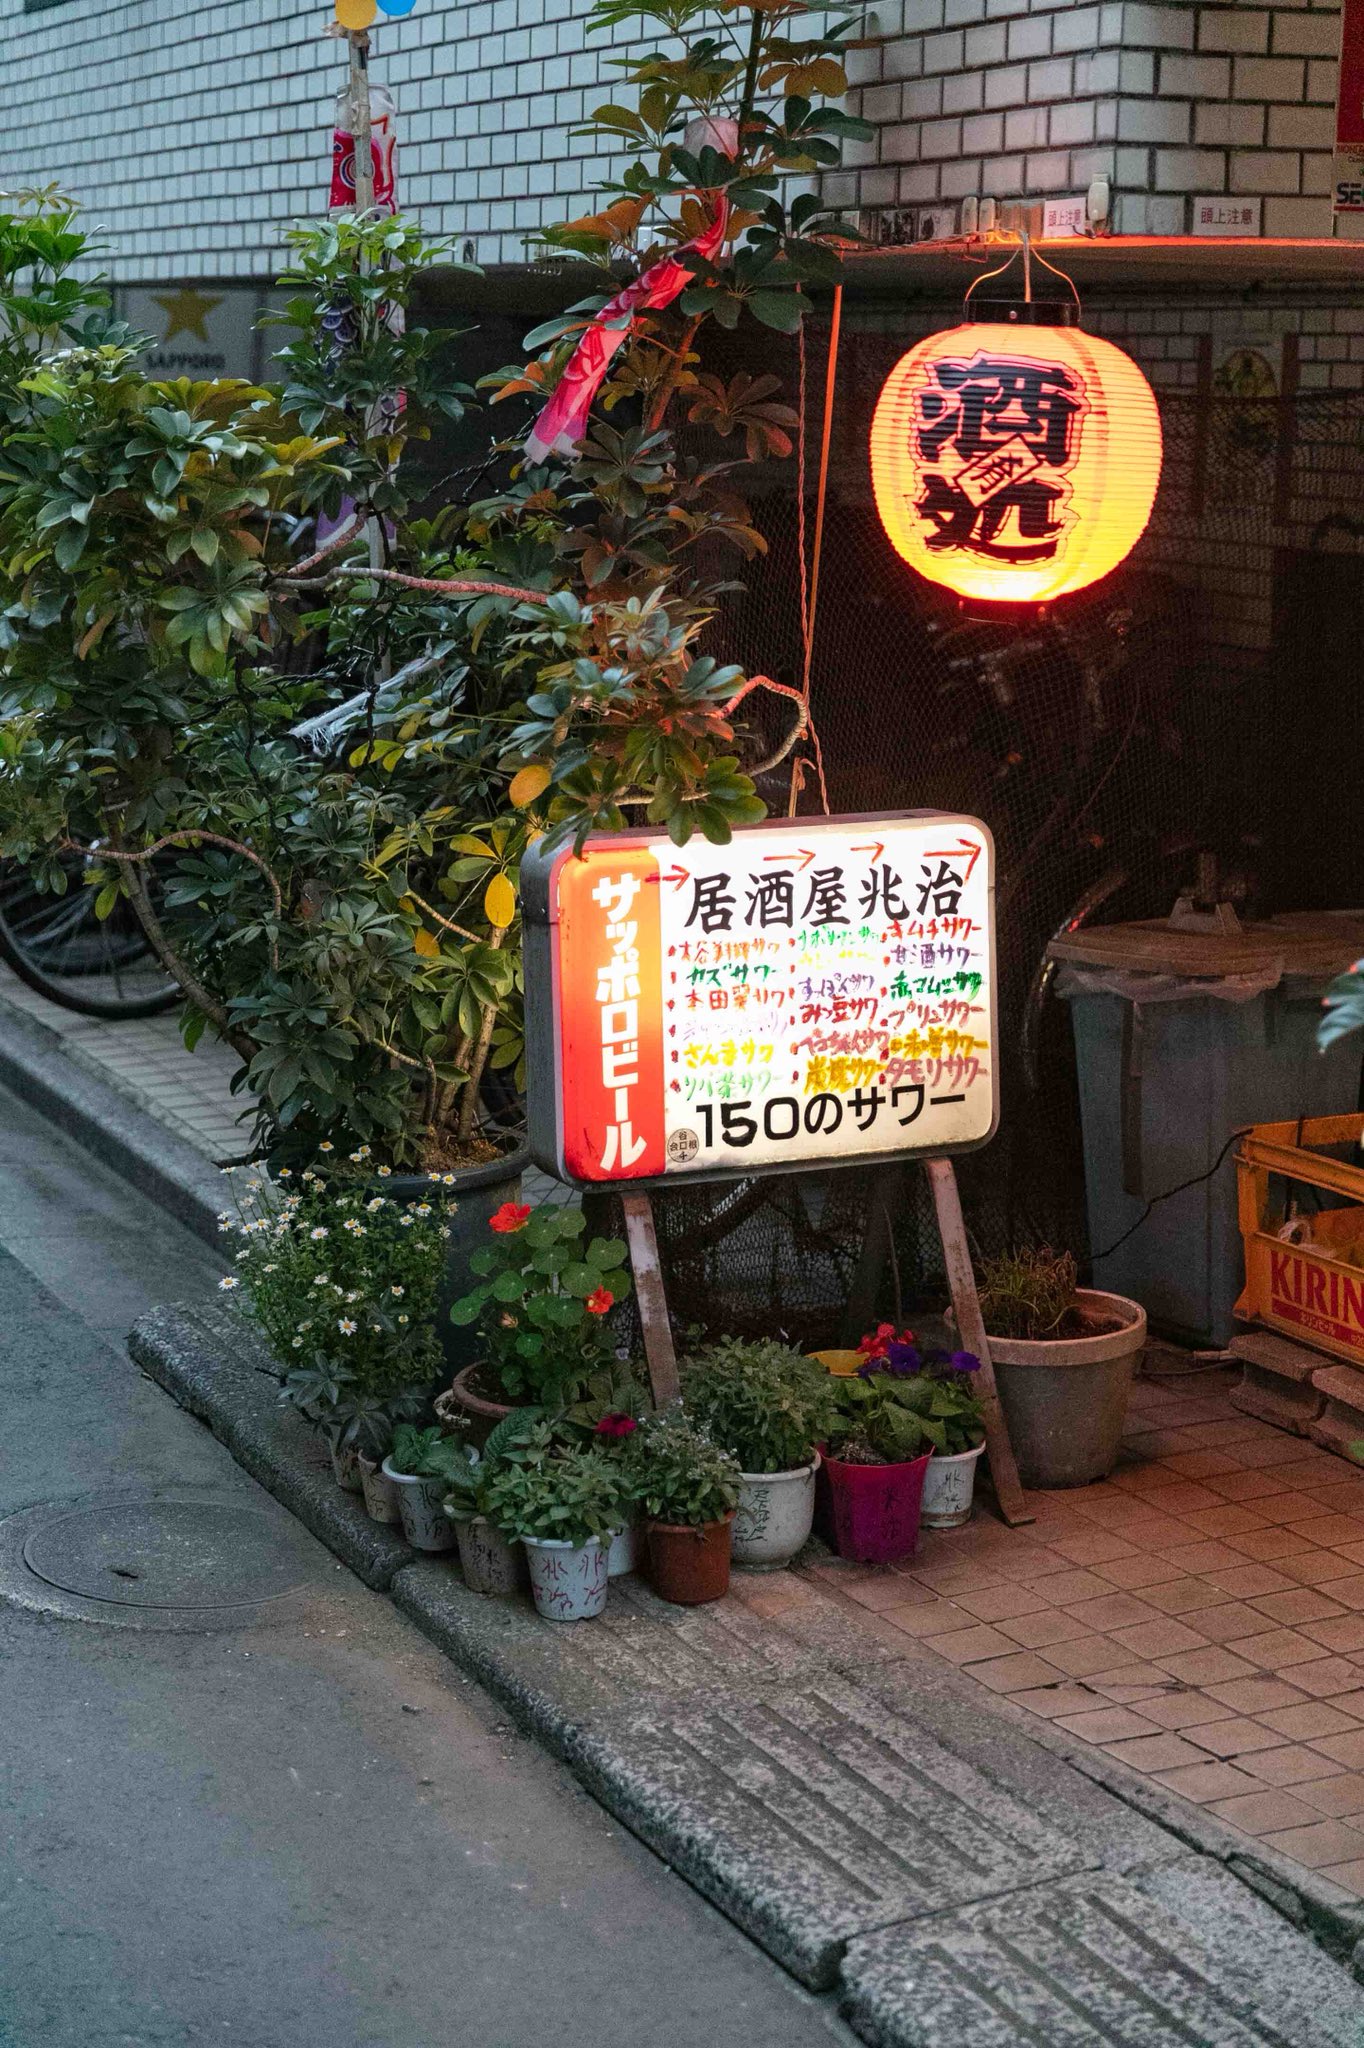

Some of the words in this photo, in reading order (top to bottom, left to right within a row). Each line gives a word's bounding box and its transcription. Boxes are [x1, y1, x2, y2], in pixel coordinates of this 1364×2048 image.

[1048, 209, 1082, 227] 頭上注意
[1201, 207, 1253, 225] 頭上注意
[684, 859, 964, 935] 居酒屋兆治
[592, 872, 647, 1172] サッポロビール
[696, 1083, 966, 1148] 150のサワー
[1270, 1250, 1364, 1330] KIRIN
